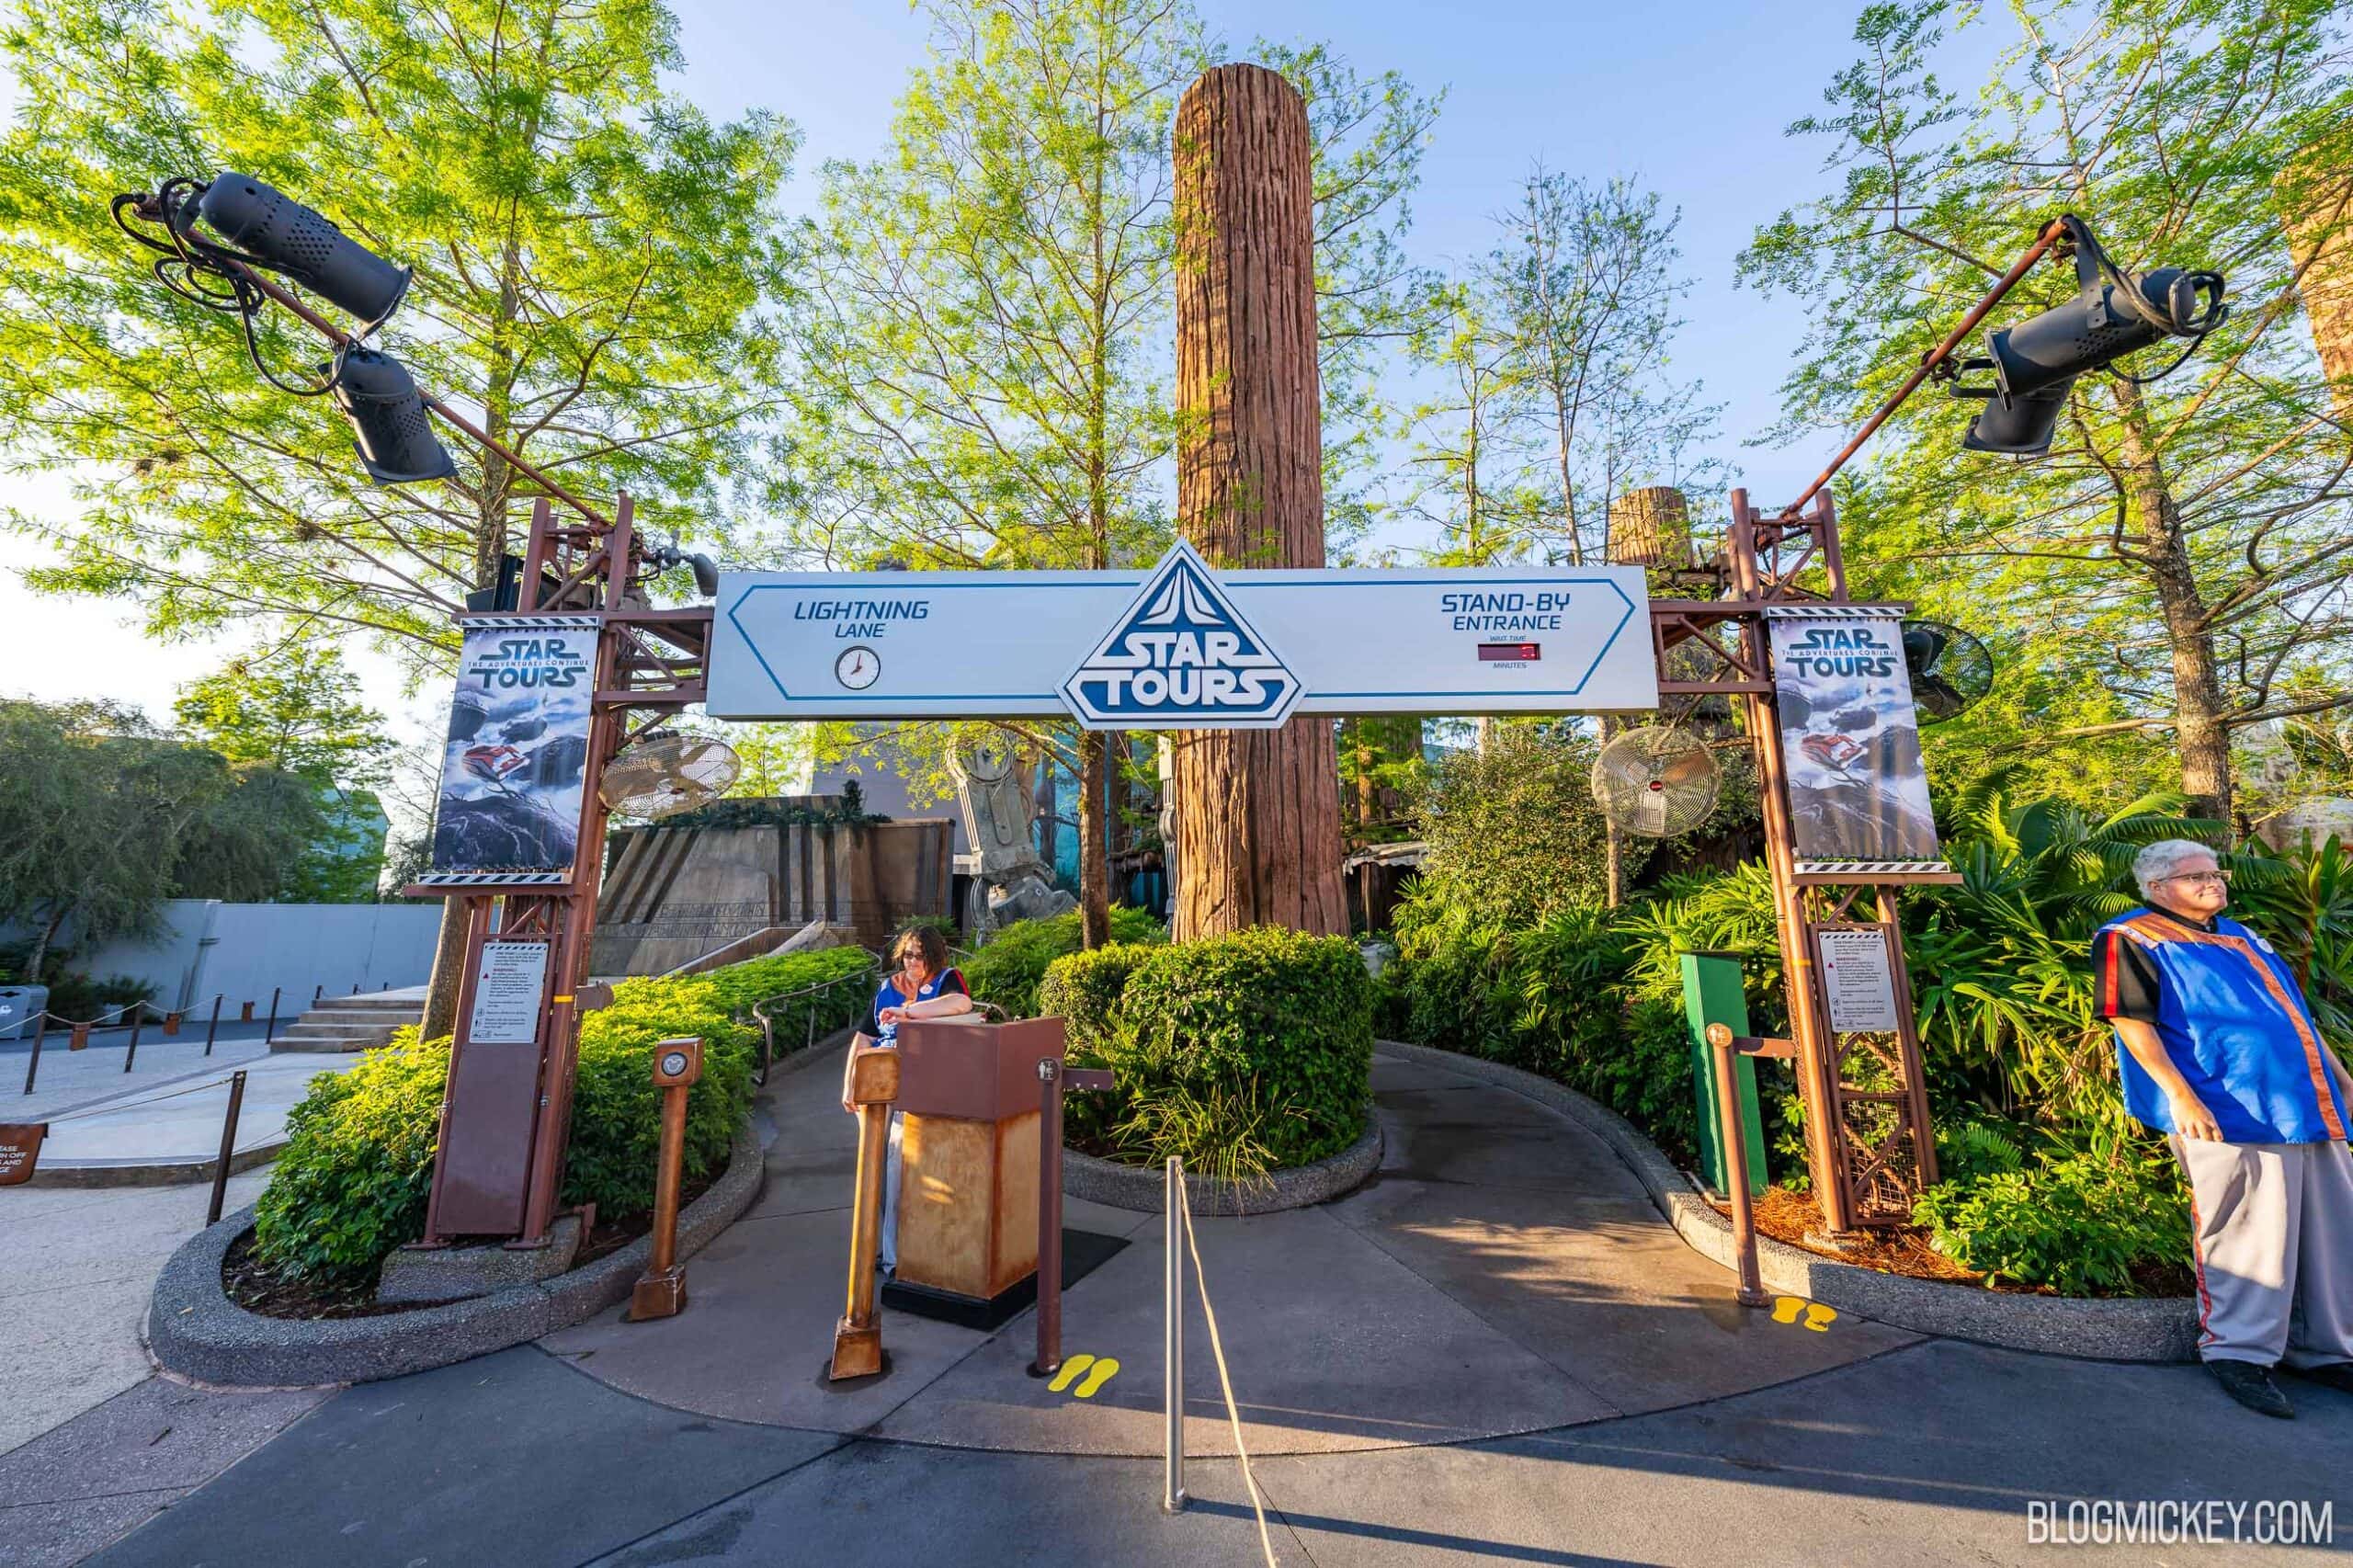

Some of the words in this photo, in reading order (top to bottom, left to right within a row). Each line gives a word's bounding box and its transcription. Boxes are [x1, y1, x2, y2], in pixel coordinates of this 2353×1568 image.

[794, 601, 930, 619] LIGHTNING
[1441, 593, 1570, 612] STAND-BY
[834, 623, 886, 638] LANE
[1453, 615, 1562, 631] ENTRANCE
[1099, 631, 1265, 667] STAR
[1789, 629, 1890, 649] STAR
[478, 639, 580, 660] STAR
[469, 666, 586, 688] TOURS
[1786, 657, 1898, 677] TOURS
[1081, 669, 1283, 706] TOURS
